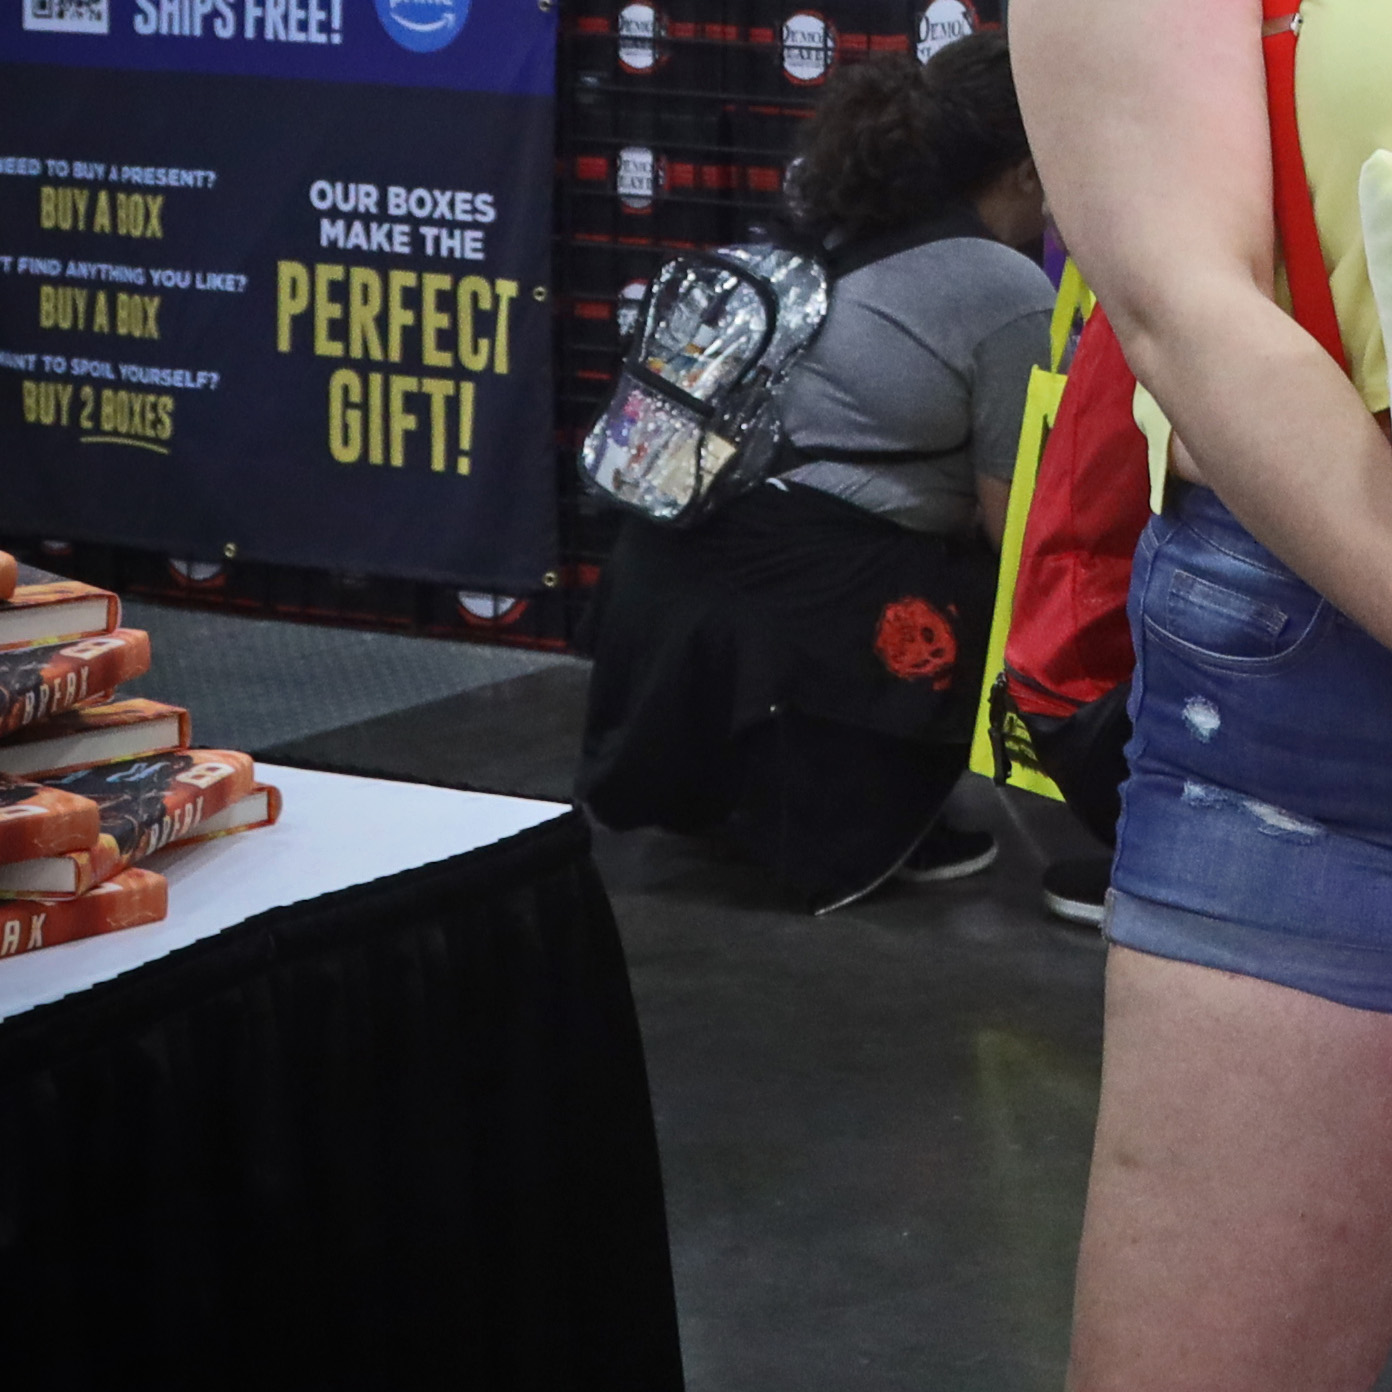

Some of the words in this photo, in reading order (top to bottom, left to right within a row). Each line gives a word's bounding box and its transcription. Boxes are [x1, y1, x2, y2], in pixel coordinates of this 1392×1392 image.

[47, 159, 70, 178] TO
[72, 160, 107, 181] BUY
[108, 165, 119, 182] A
[121, 166, 217, 190] PRESENT?
[40, 185, 90, 231] BUY
[93, 189, 112, 235] A
[116, 191, 166, 240] BOX
[309, 178, 379, 215] OUR
[387, 185, 497, 224] BOXES
[319, 217, 411, 255] MAKE
[419, 224, 486, 261] THE
[17, 256, 62, 278] FIND
[65, 259, 147, 286] ANYTHING
[149, 268, 192, 290] YOU
[195, 271, 249, 294] LIKE?
[39, 284, 88, 330] BUY
[93, 288, 110, 335] A
[116, 291, 162, 341] BOX
[276, 259, 519, 375] PERFECT
[42, 354, 67, 374] TO
[70, 357, 116, 381] SPOIL
[118, 363, 221, 391] YOURSELF?
[22, 379, 73, 427] BUY
[79, 384, 95, 430] 2
[101, 388, 175, 441] BOXES
[327, 367, 476, 476] GIFT!
